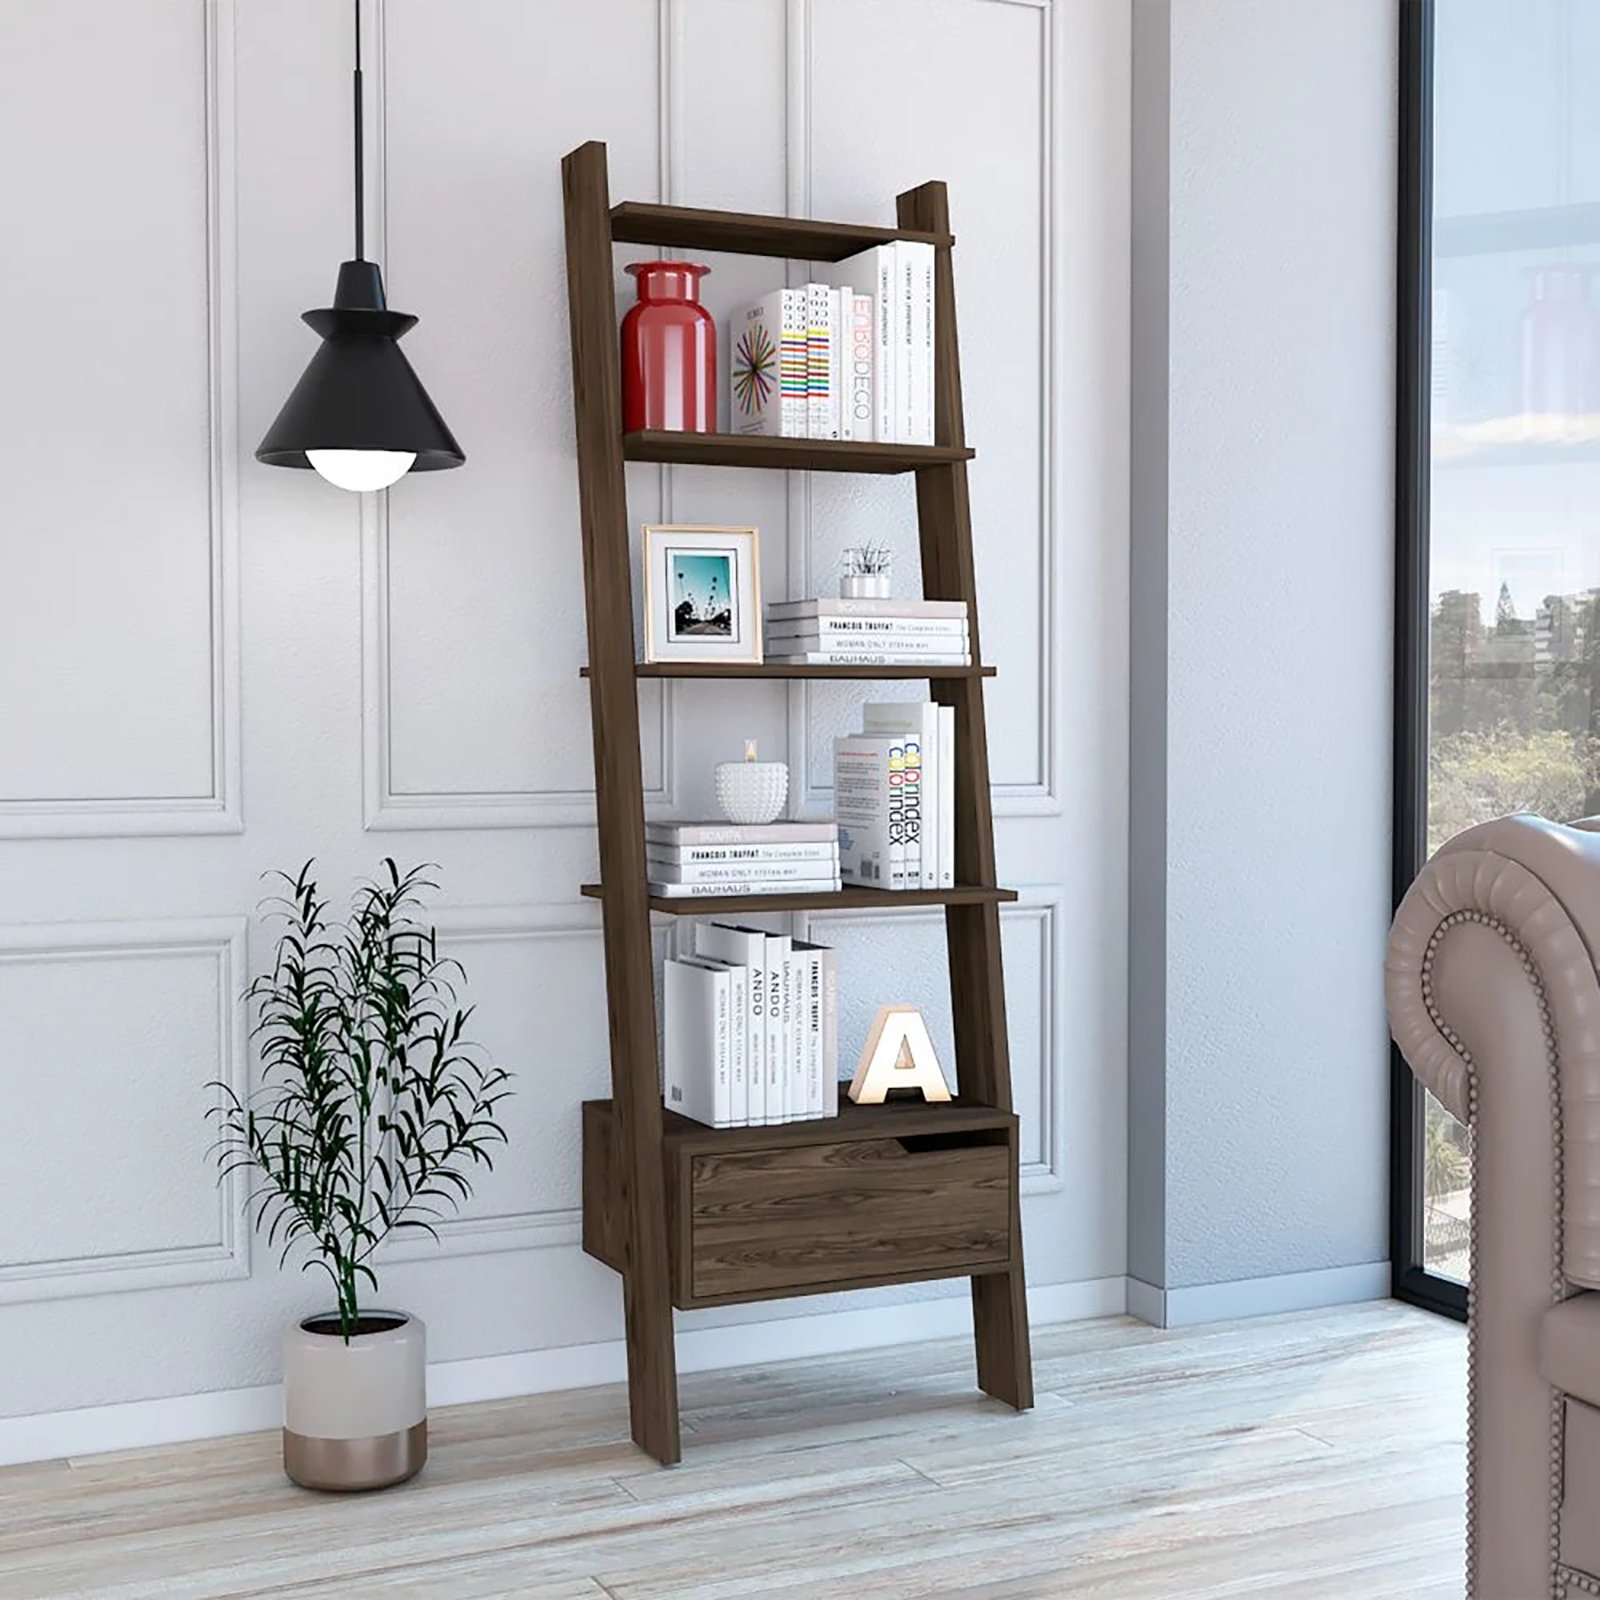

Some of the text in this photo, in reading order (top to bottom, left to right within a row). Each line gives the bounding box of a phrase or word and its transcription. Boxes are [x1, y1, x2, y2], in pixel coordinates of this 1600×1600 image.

[829, 655, 886, 664] BAUHAUS
[888, 747, 904, 846] colorindex
[904, 742, 922, 844] colorindex
[691, 884, 751, 895] BAUHAUS
[752, 968, 762, 1016] ANDO
[770, 971, 780, 1018] ANDO
[849, 1005, 952, 1104] A
